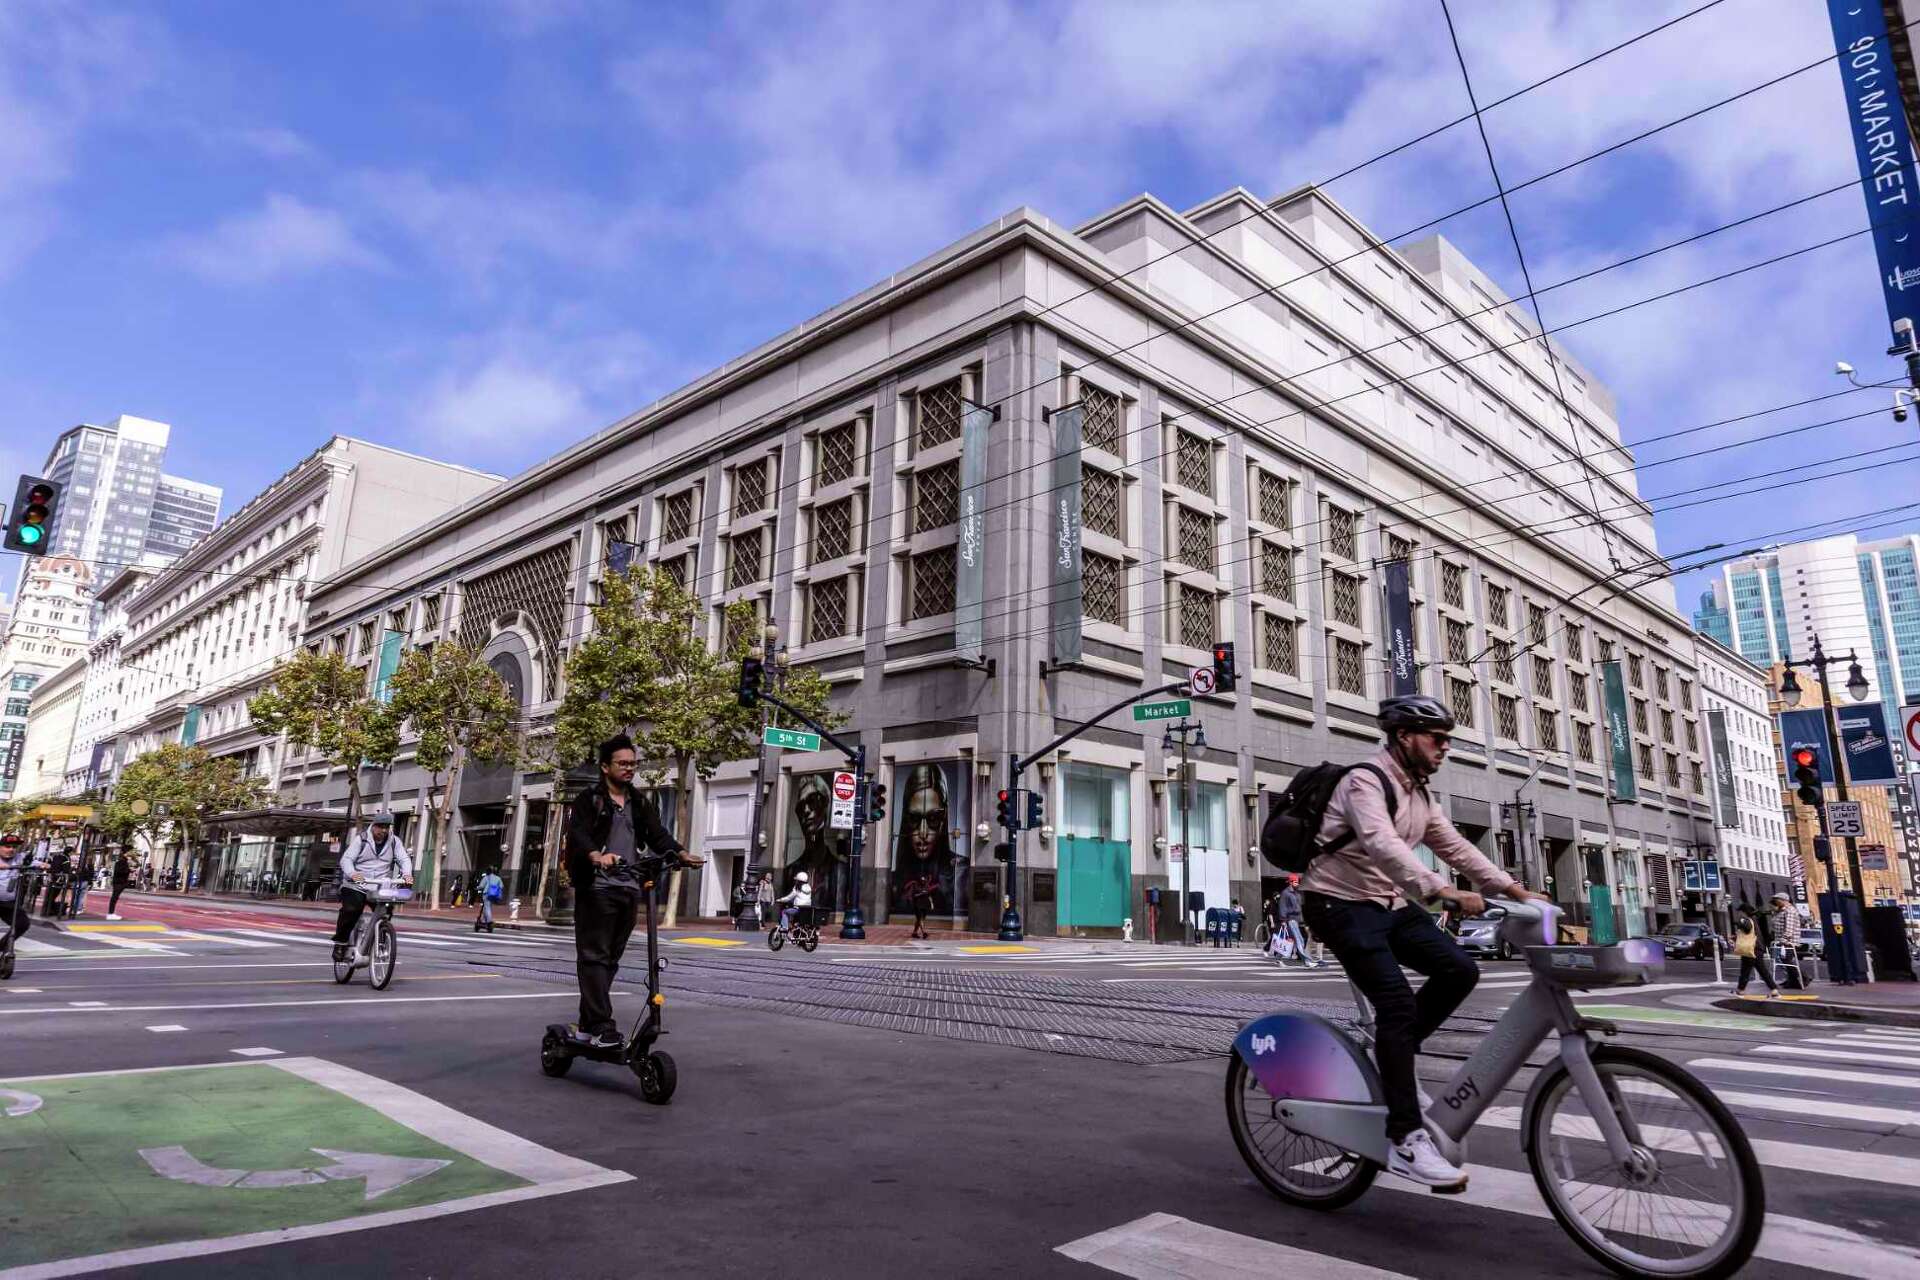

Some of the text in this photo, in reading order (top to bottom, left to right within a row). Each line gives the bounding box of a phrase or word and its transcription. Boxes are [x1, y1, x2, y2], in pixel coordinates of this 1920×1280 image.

[1849, 36, 1908, 206] 901 MARKET
[1059, 499, 1073, 569] San Francisco
[1144, 704, 1180, 718] Market
[778, 732, 807, 746] 5th St
[1891, 743, 1909, 795] HOTEL
[1832, 820, 1860, 833] 25
[1251, 1033, 1276, 1056] lyft
[1443, 1076, 1481, 1110] bay
